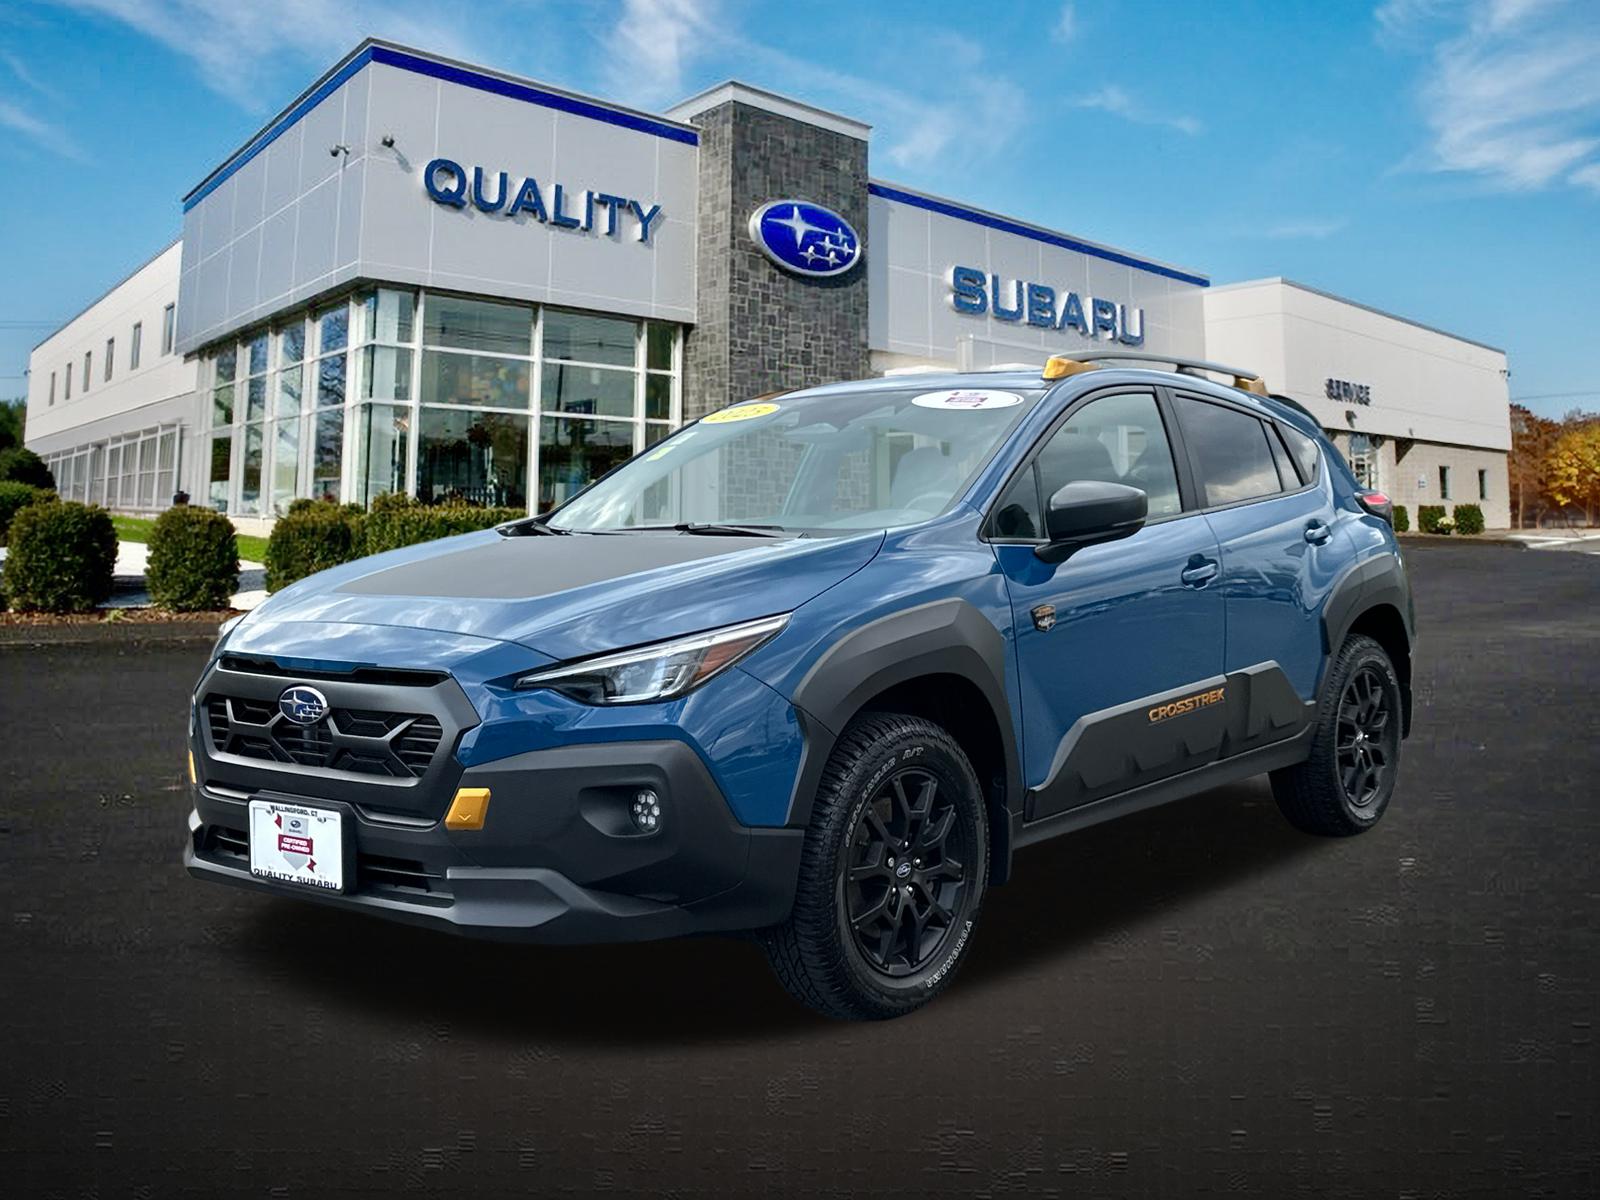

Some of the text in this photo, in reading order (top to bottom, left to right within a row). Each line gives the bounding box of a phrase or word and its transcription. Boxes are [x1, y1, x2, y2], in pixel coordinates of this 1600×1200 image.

[424, 158, 661, 242] QUALITY
[950, 265, 1144, 346] SUBARU
[1148, 687, 1225, 722] CROSSTREK
[253, 868, 337, 889] QUALITY SUBARU
